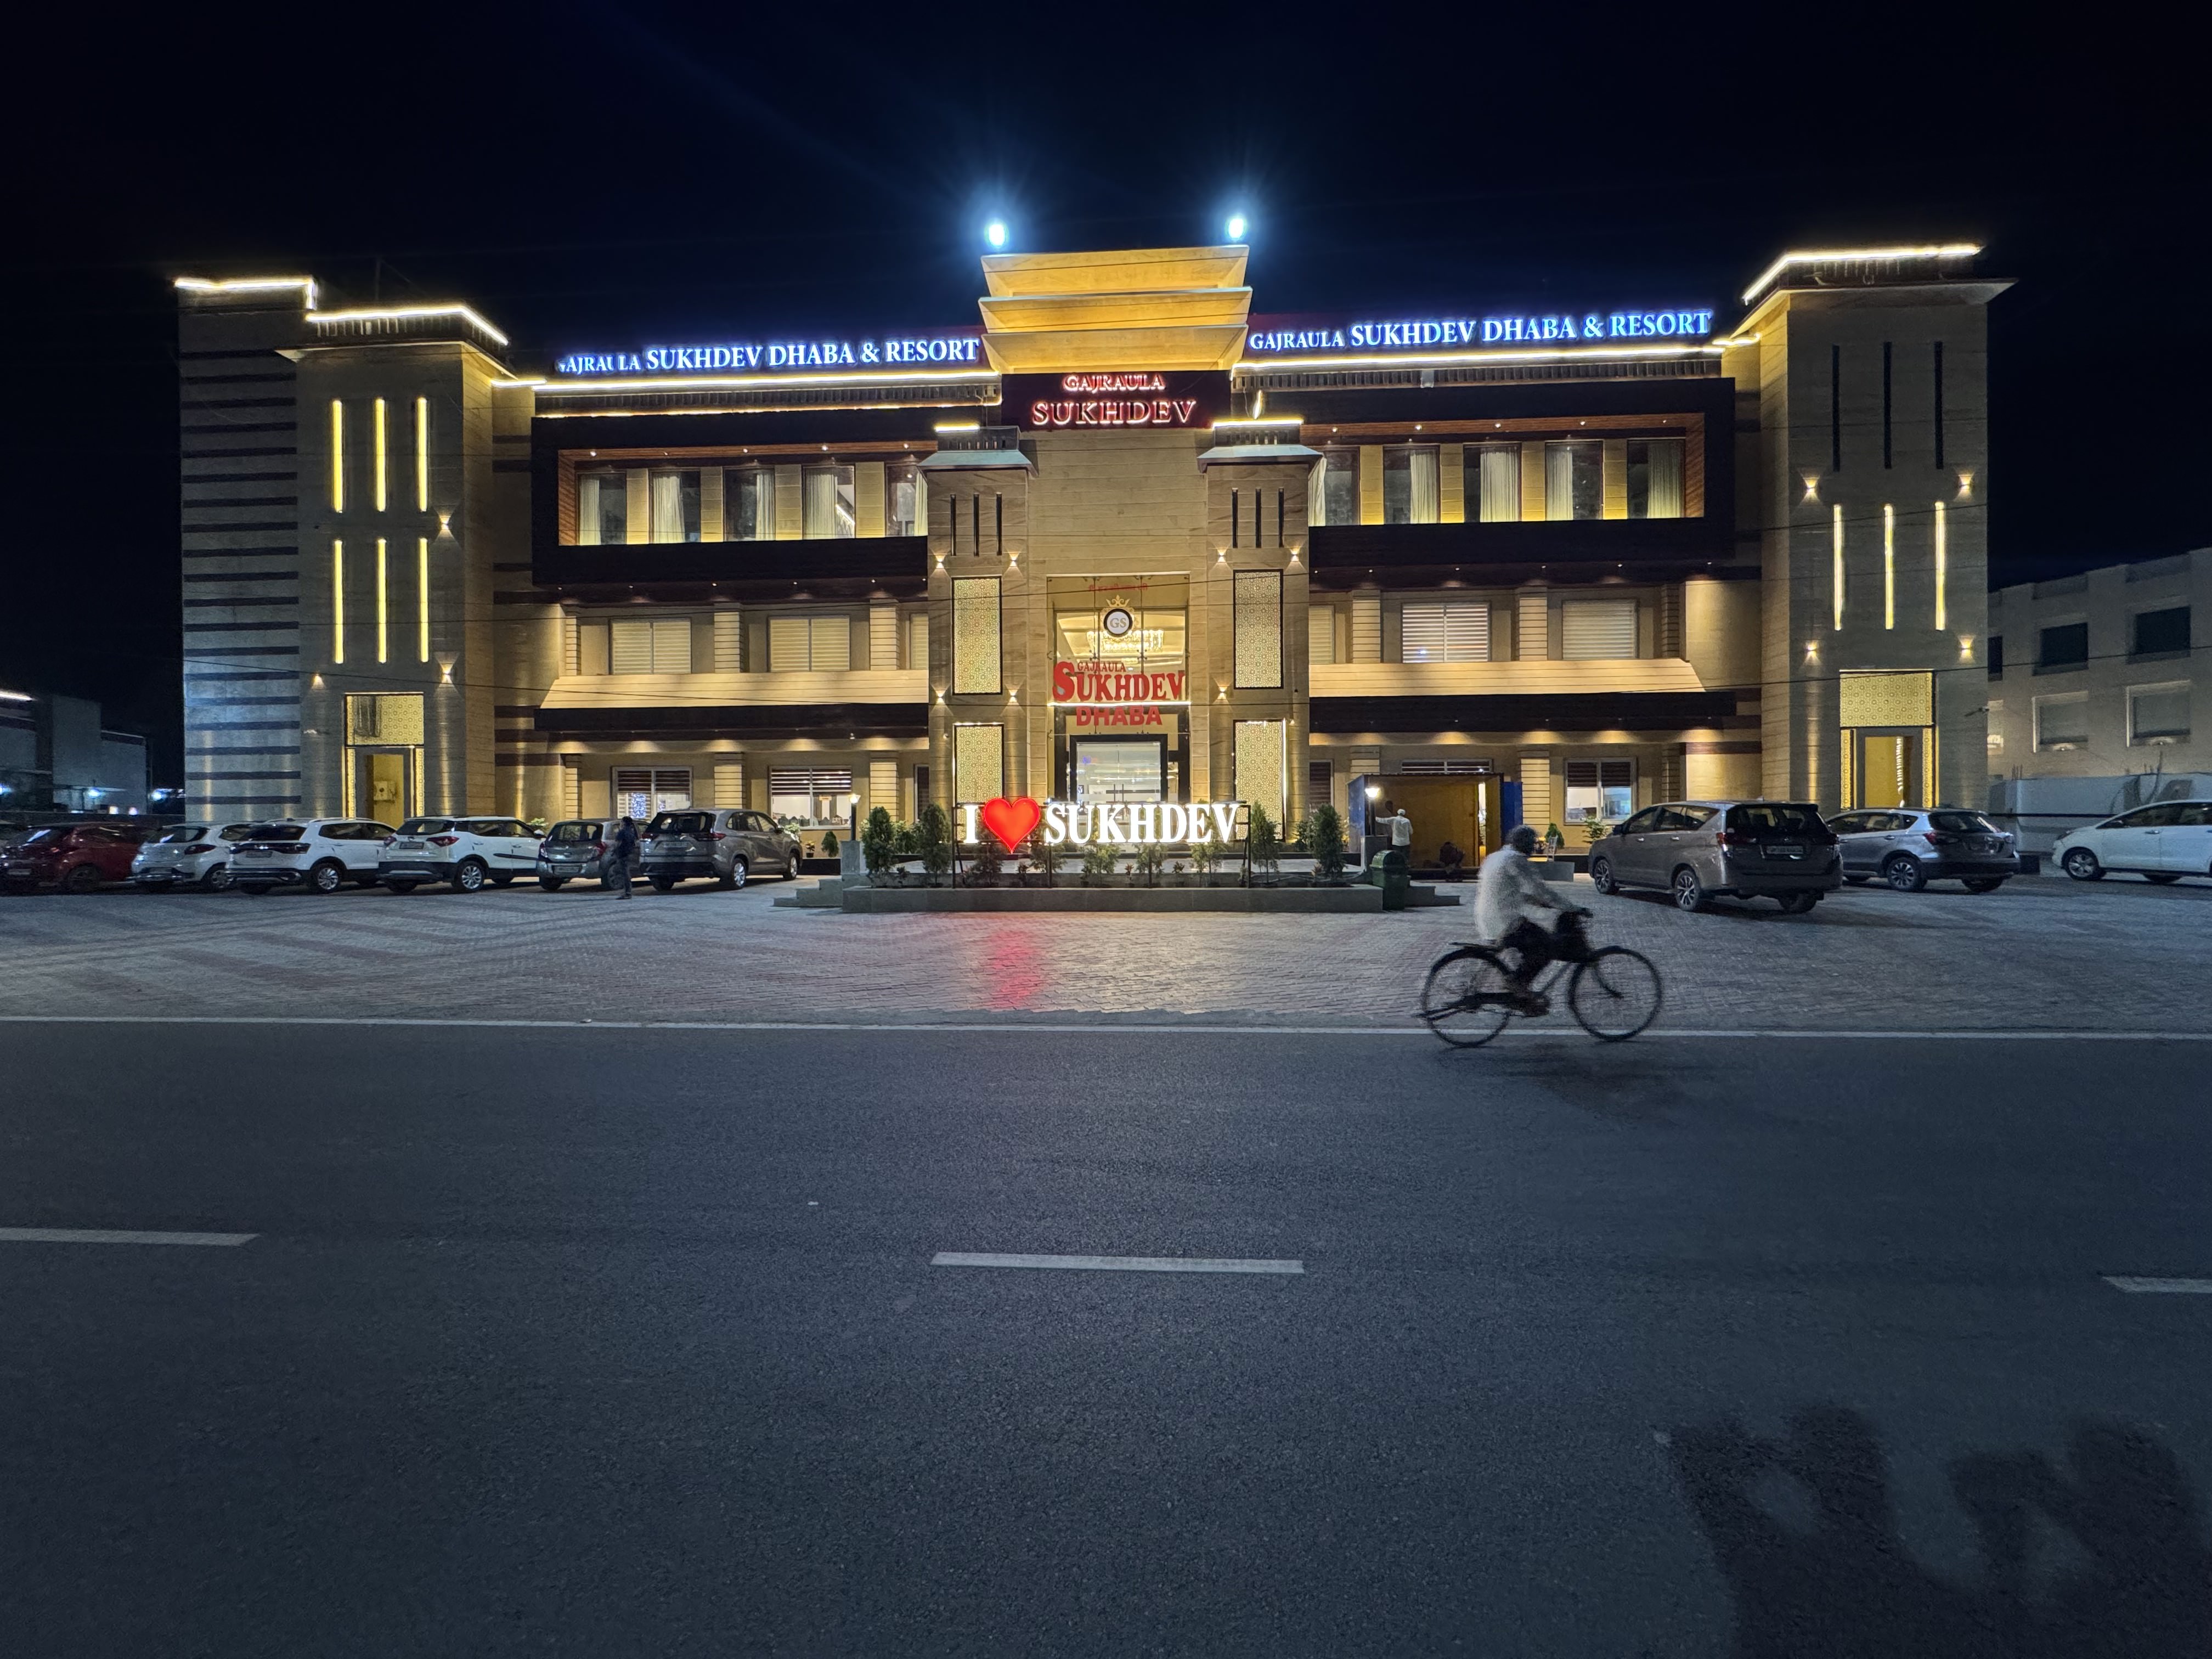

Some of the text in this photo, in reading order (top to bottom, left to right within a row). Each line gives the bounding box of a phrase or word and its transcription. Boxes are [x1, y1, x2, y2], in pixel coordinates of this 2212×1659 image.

[1250, 310, 1712, 352] GAJRAULA SUKHDEV DHABA & RESORT
[558, 338, 980, 375] AJRAULA SUKHDEV DHABA & RESORT
[1063, 374, 1166, 394] GAJRAULA
[1031, 400, 1197, 426] SUKHDEV
[1109, 617, 1127, 628] GS
[1052, 661, 1186, 702] SUKHDEV
[1076, 706, 1163, 726] DHABA
[963, 804, 1240, 844] I SUKHDEV
